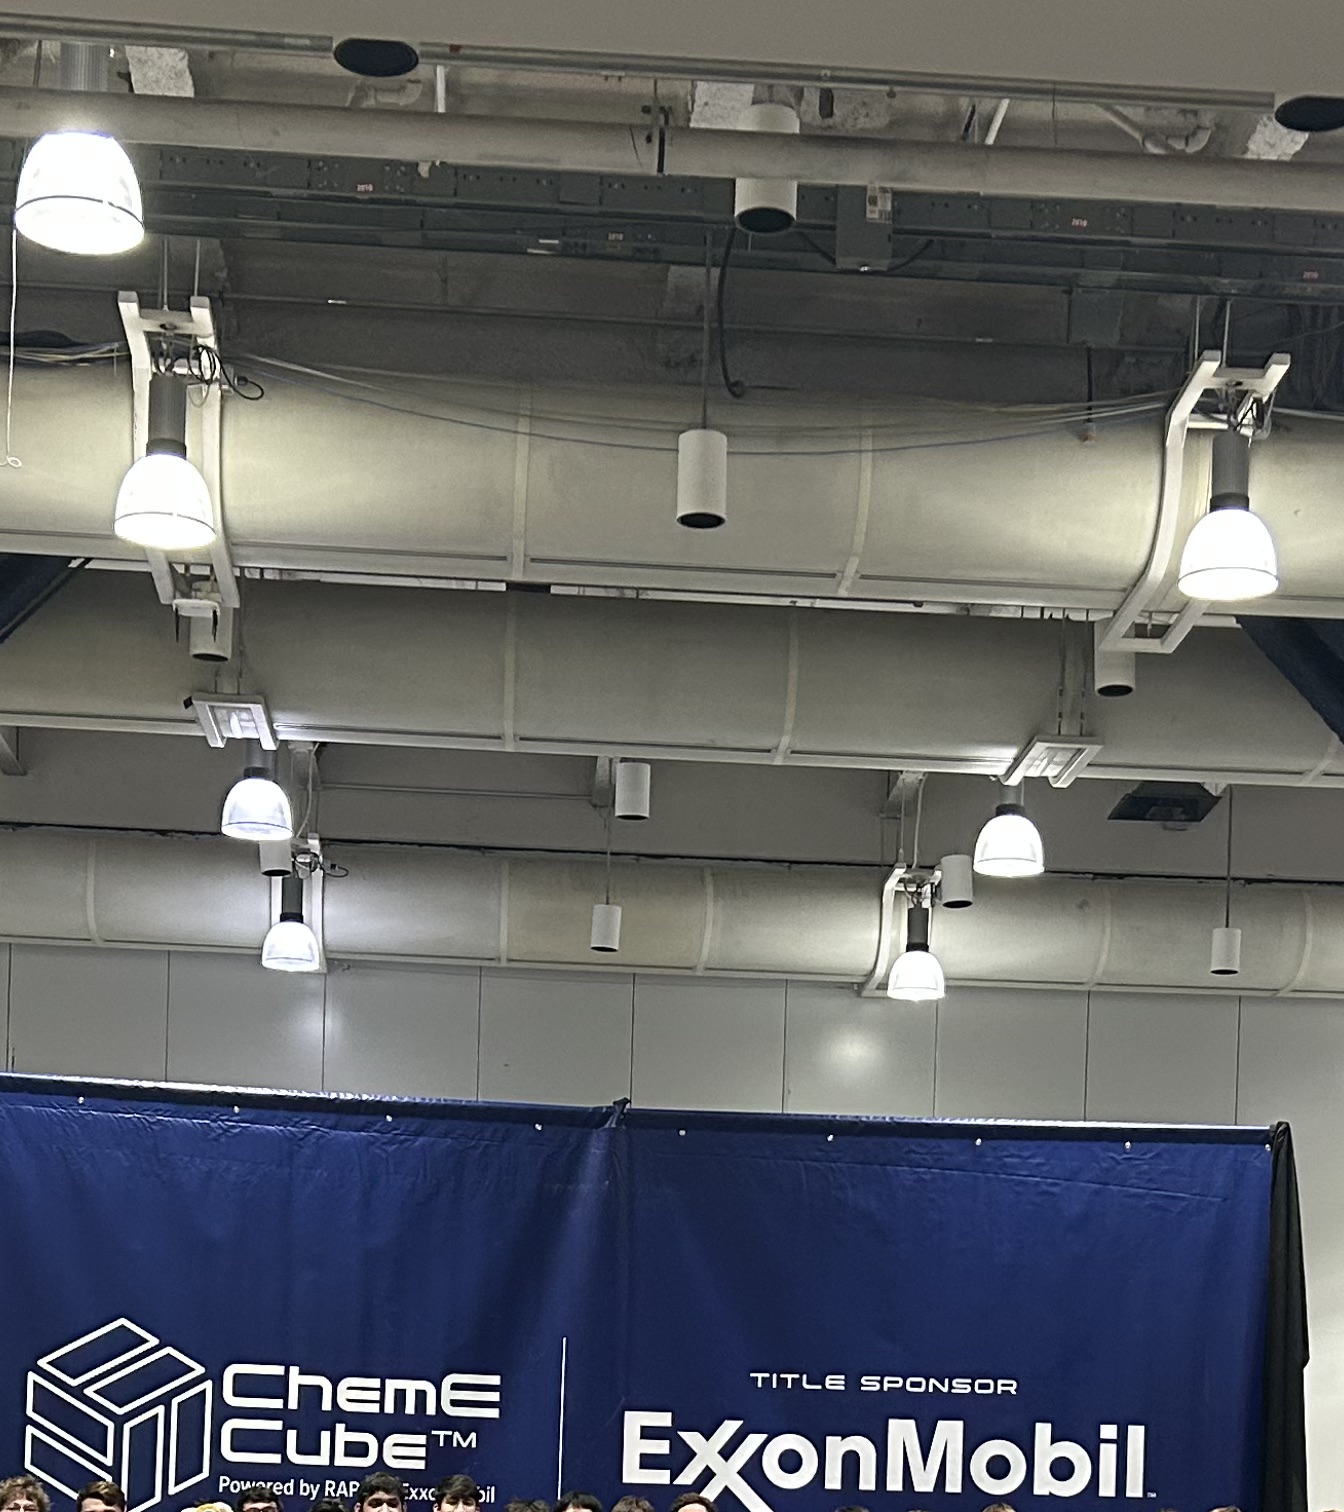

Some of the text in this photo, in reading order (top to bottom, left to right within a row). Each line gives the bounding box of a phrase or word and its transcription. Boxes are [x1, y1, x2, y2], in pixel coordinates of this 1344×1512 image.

[222, 1363, 501, 1418] ChemE
[749, 1372, 1018, 1395] TITLE SPONSOR
[299, 1478, 321, 1501] by
